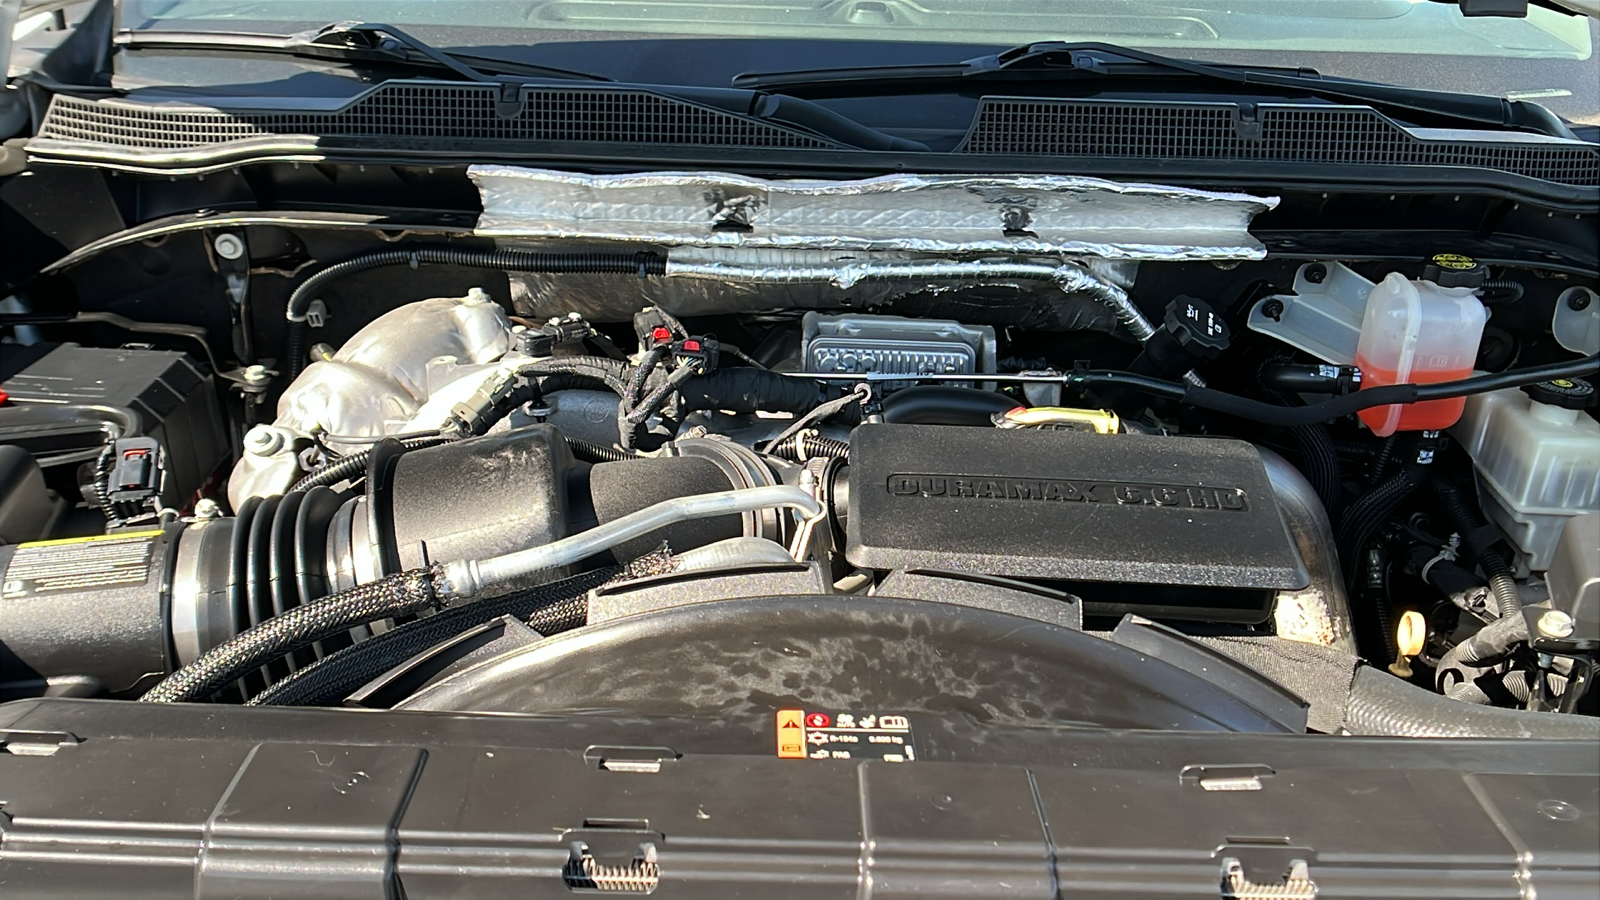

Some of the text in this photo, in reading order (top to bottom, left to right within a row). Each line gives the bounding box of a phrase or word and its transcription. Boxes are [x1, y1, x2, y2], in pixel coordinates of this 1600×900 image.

[893, 477, 1243, 510] DURAMAX 6.6 HD
